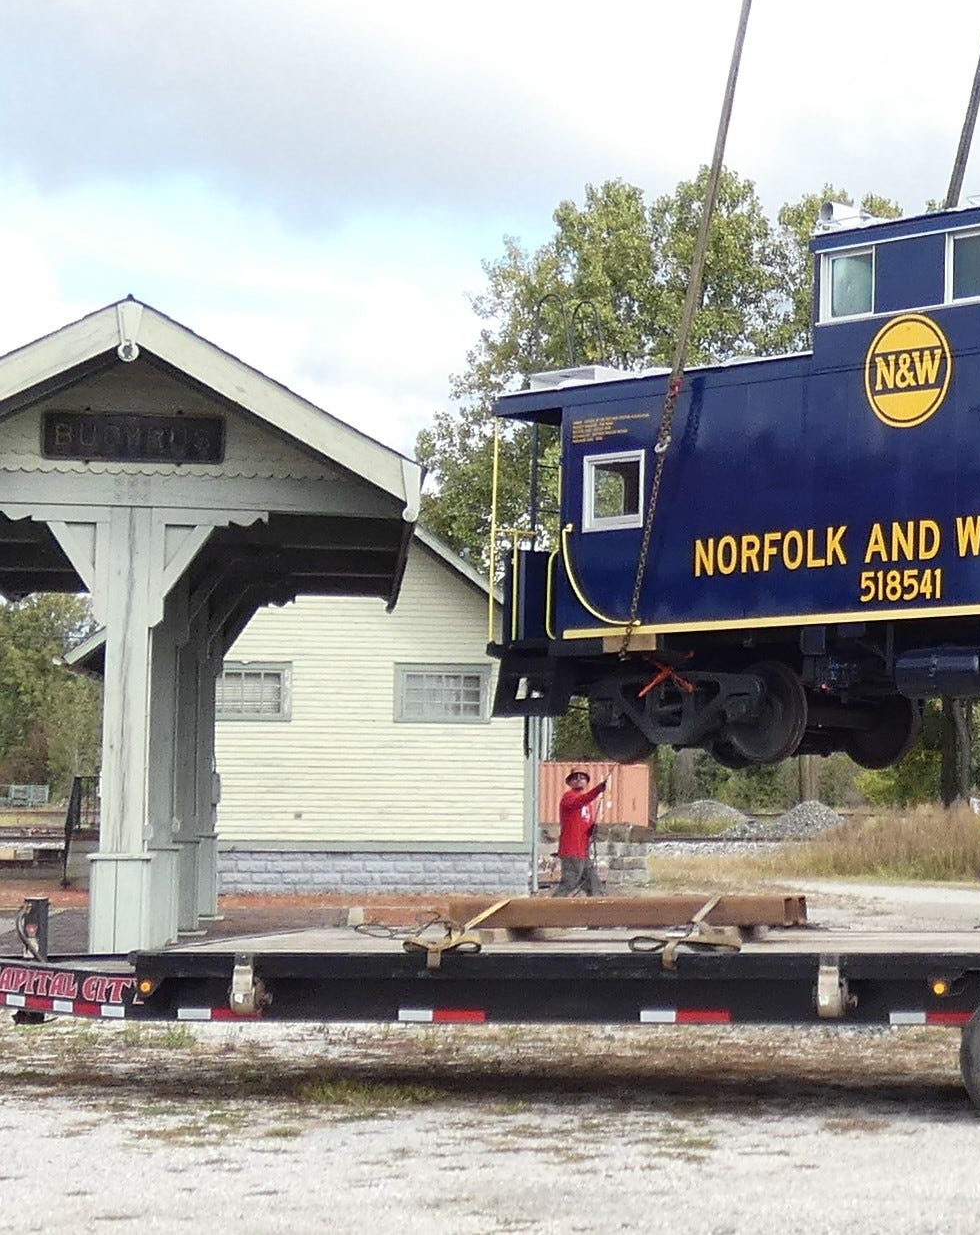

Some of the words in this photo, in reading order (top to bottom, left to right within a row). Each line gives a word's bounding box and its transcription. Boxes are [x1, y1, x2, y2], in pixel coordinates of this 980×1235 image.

[874, 348, 944, 392] N&W
[694, 525, 848, 578] NORFOLK
[864, 519, 940, 563] AND
[860, 568, 942, 603] 518541
[0, 966, 79, 999] APITAL
